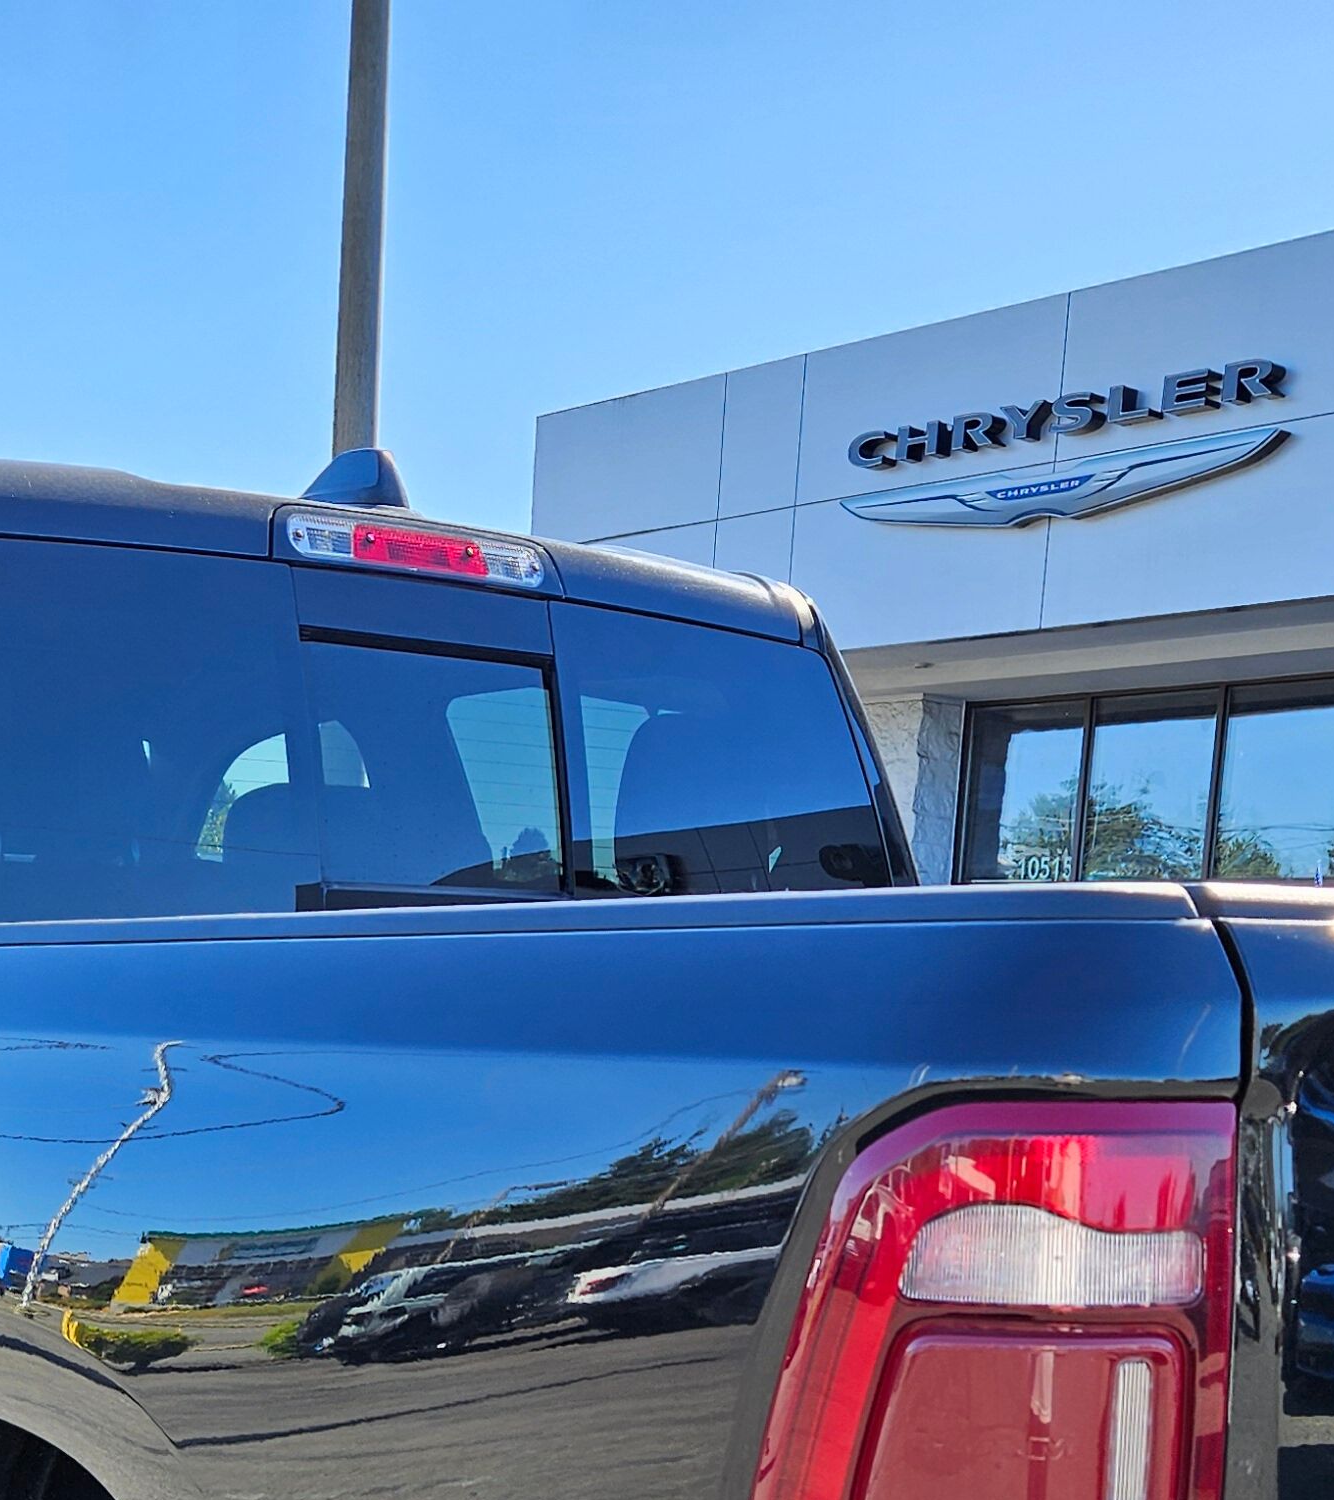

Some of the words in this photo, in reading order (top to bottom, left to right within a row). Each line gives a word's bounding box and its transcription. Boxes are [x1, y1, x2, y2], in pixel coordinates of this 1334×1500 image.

[847, 357, 1287, 471] CHRYSLER
[996, 479, 1080, 499] CHRYSLER
[1018, 856, 1072, 881] 10515
